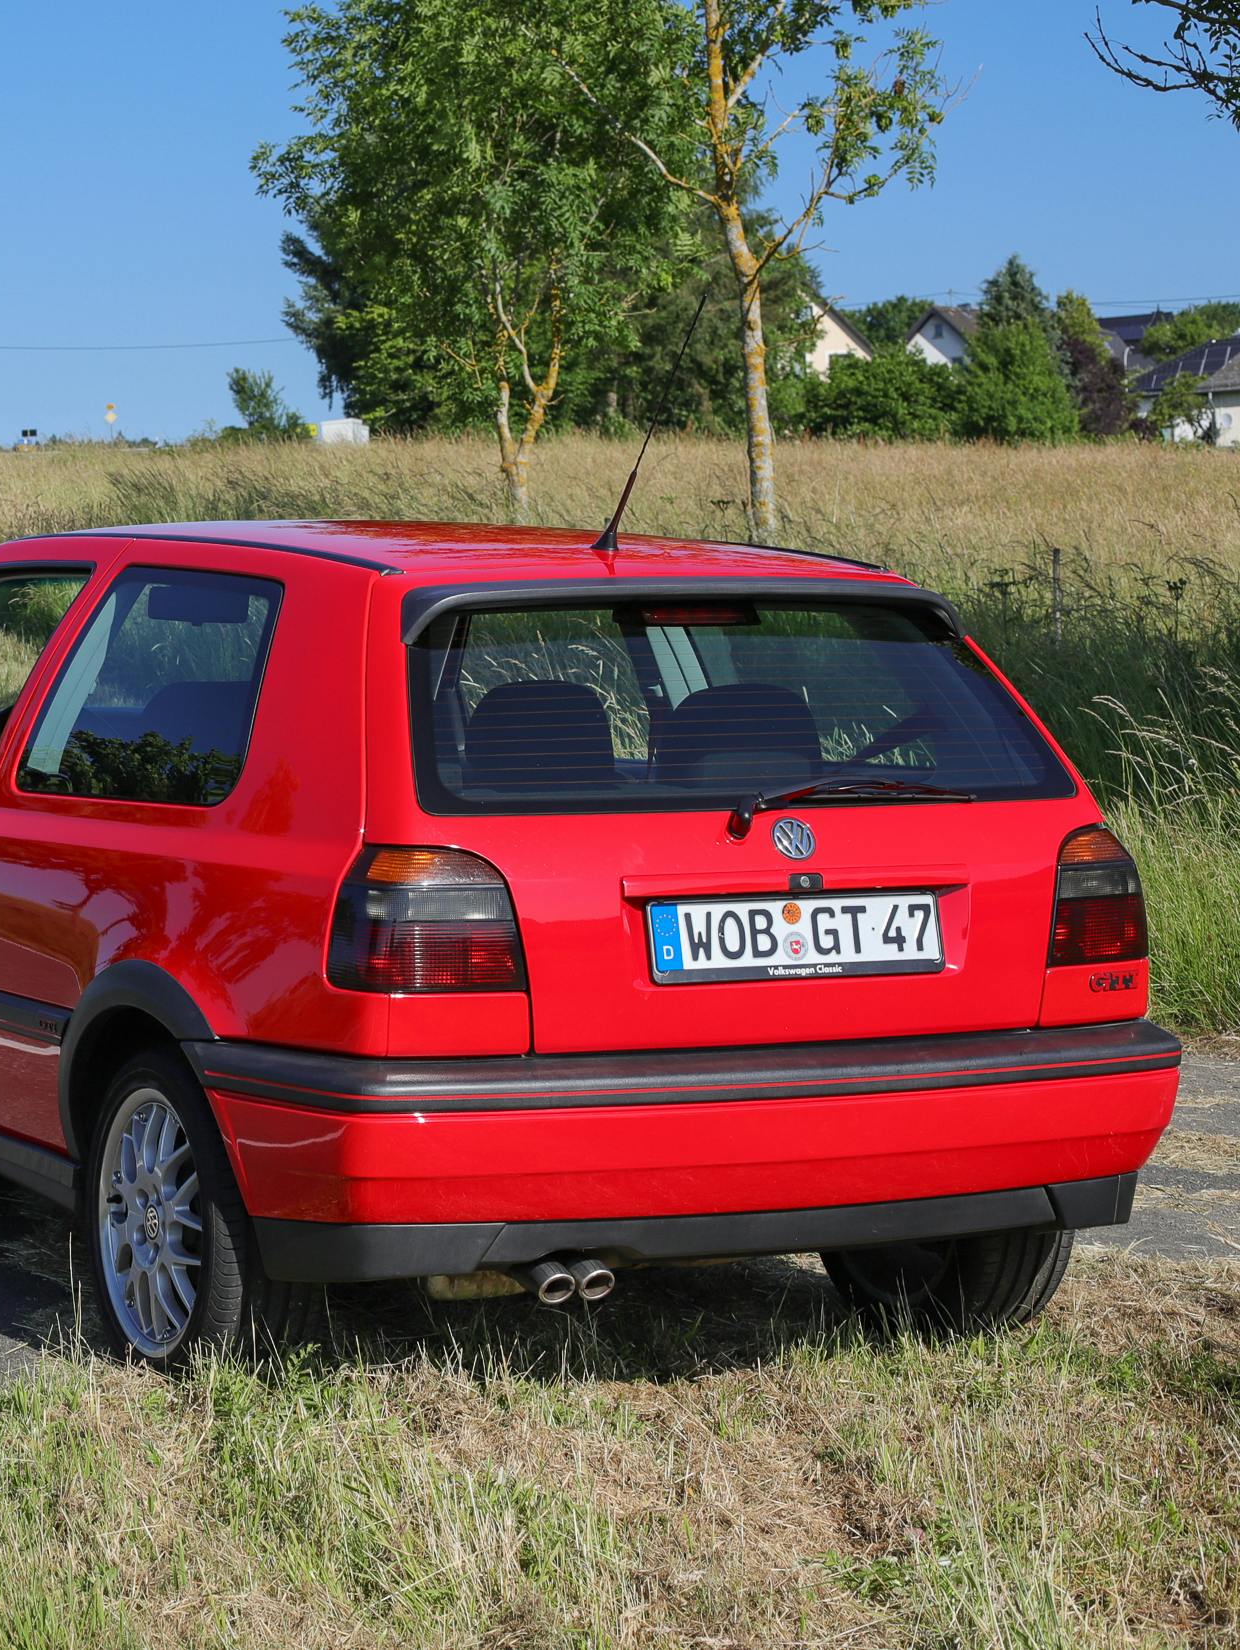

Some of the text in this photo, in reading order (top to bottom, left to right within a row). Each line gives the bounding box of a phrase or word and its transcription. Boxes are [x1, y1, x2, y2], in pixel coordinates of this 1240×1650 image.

[684, 904, 931, 961] WOB GT 47
[663, 945, 674, 960] D
[767, 964, 843, 976] Volkswagen Classic
